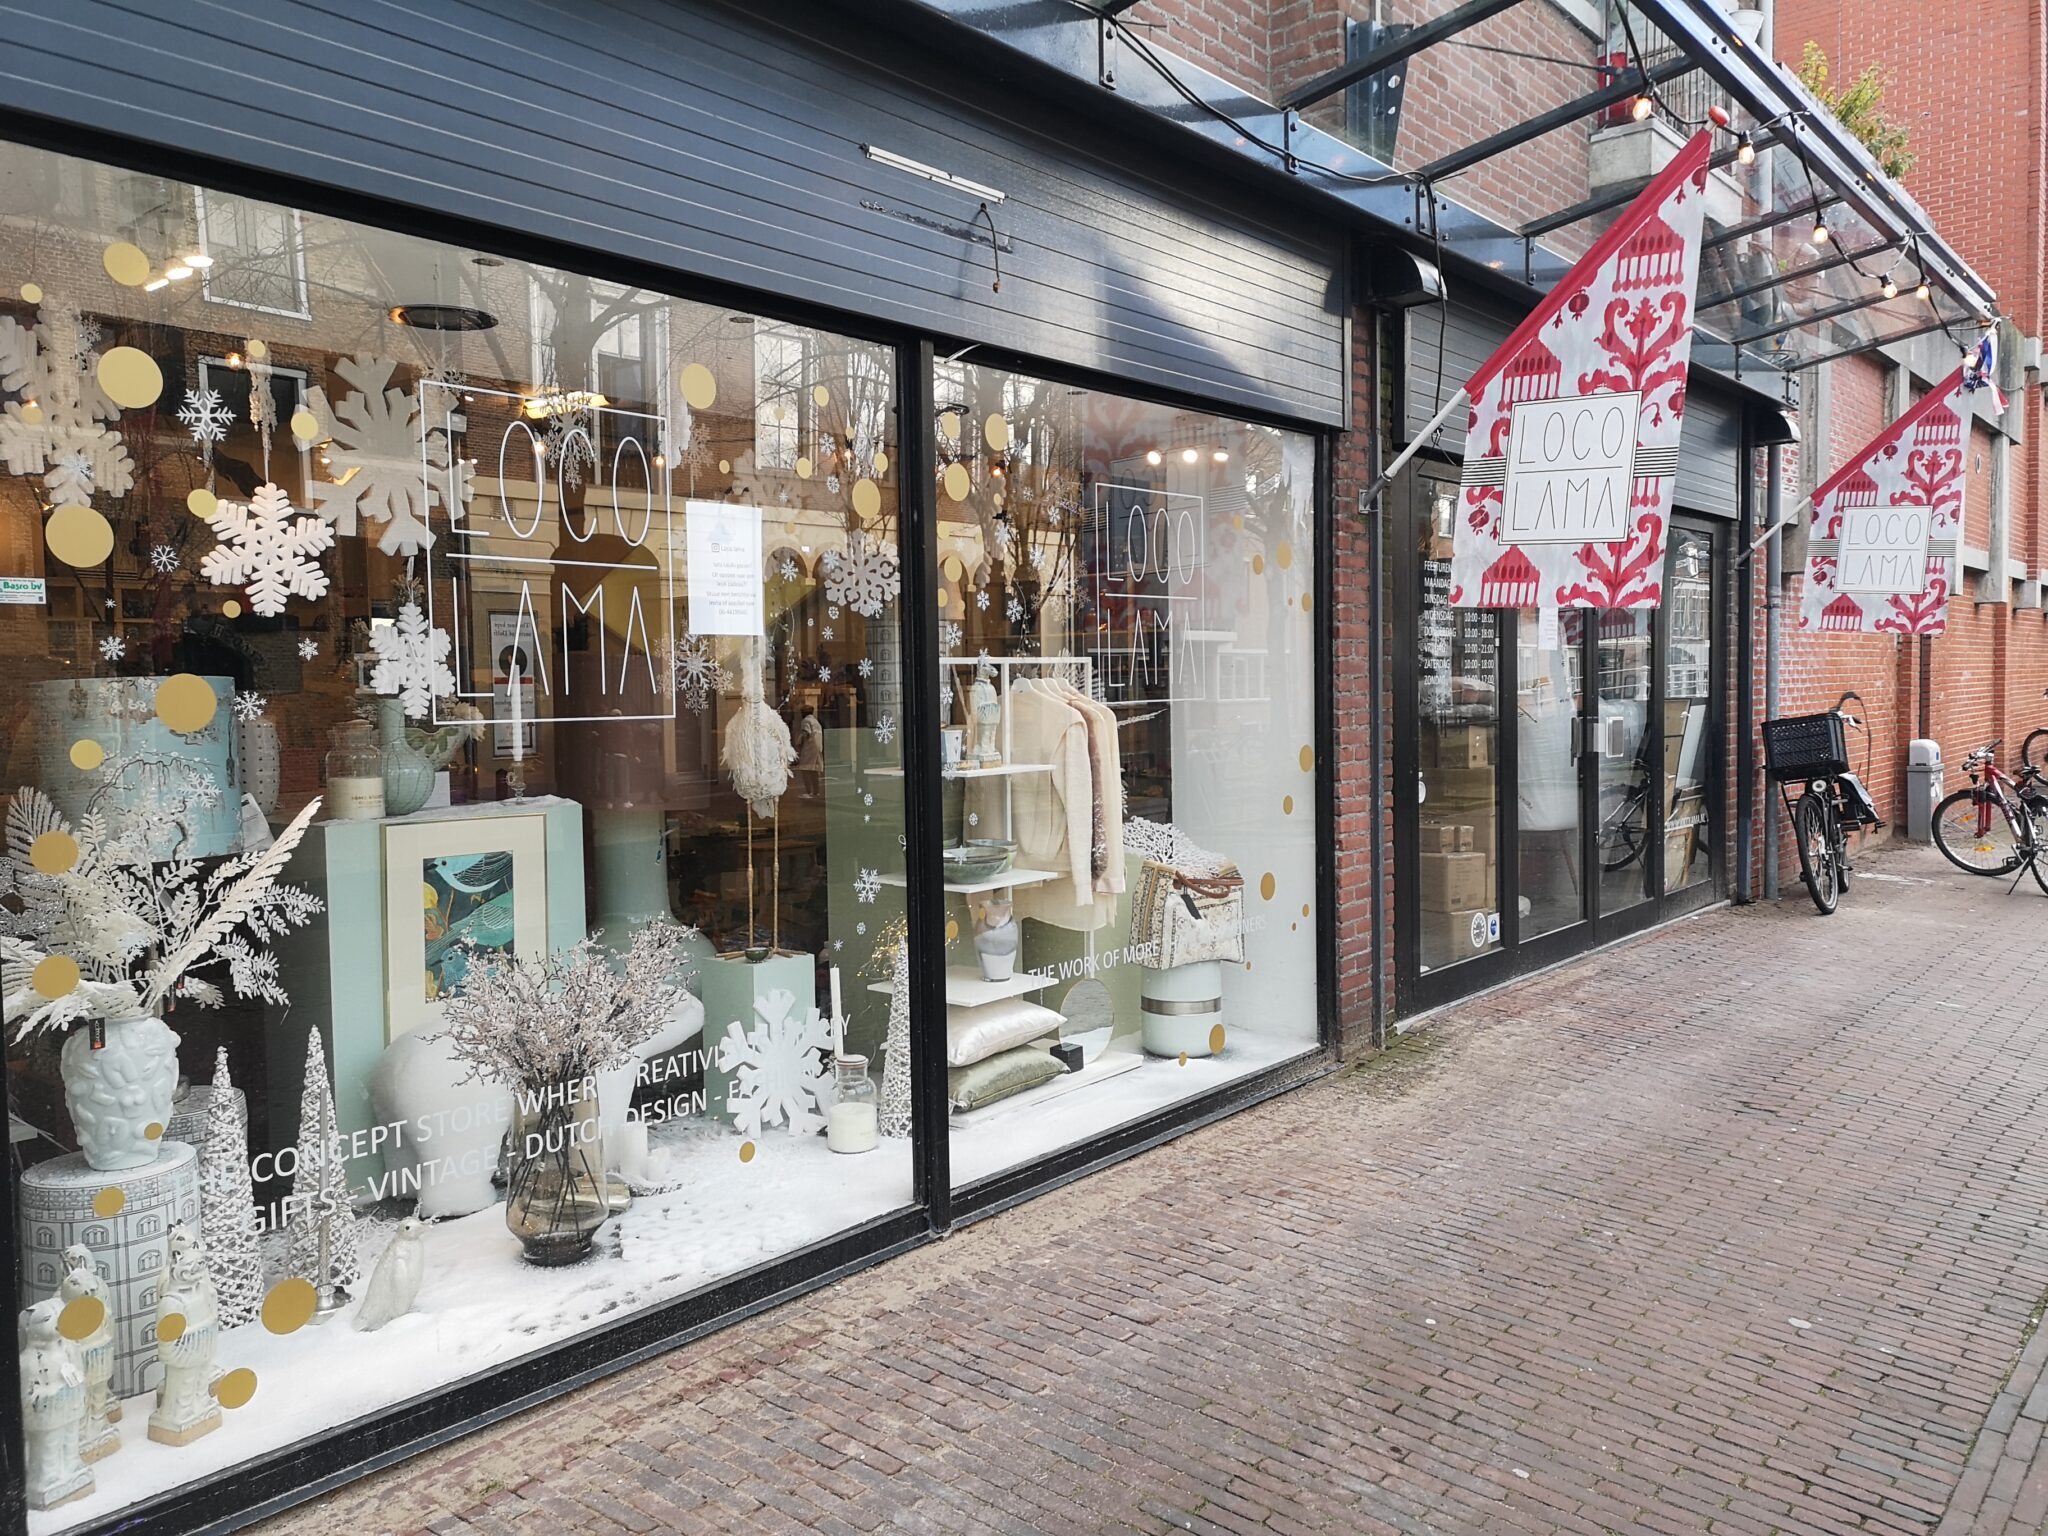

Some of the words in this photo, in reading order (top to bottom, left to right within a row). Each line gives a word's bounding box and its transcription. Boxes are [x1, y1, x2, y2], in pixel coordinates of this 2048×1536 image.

[1519, 406, 1625, 464] LOCO
[446, 410, 652, 546] LOCO
[1512, 477, 1615, 530] LAMA
[1105, 501, 1196, 584] LOCO
[1847, 513, 1922, 545] LOCO
[3, 581, 29, 590] Basro
[31, 582, 42, 590] bv
[1424, 577, 1451, 589] MAANDAG
[1843, 554, 1915, 586] LAMA
[1424, 593, 1448, 605] DINSDAG
[1424, 610, 1454, 621] WOENSDAG
[1464, 612, 1478, 622] 10:00
[1481, 613, 1495, 623] 18:00
[453, 576, 657, 697] LAMA
[1107, 608, 1197, 687] LAMA
[1464, 628, 1478, 638] 10:00
[1481, 628, 1495, 639] 18:00
[1464, 643, 1478, 654] 10:00
[1481, 644, 1495, 654] 21:00
[1424, 659, 1451, 669] ZATERDAG
[1464, 659, 1478, 669] 10:00
[1481, 659, 1495, 669] 18:00
[1028, 965, 1055, 980] THE
[1059, 955, 1099, 981] WORK
[1103, 948, 1120, 969] OF
[1123, 941, 1161, 964] MORE
[251, 1120, 408, 1183] CONCEPT
[416, 1097, 508, 1143] STORE
[516, 1076, 598, 1116] WHER
[244, 1187, 338, 1237] GIFTS
[367, 1144, 498, 1201] VINTAGE
[525, 1117, 614, 1160] DUTCH
[626, 1088, 707, 1127] DESIGN
